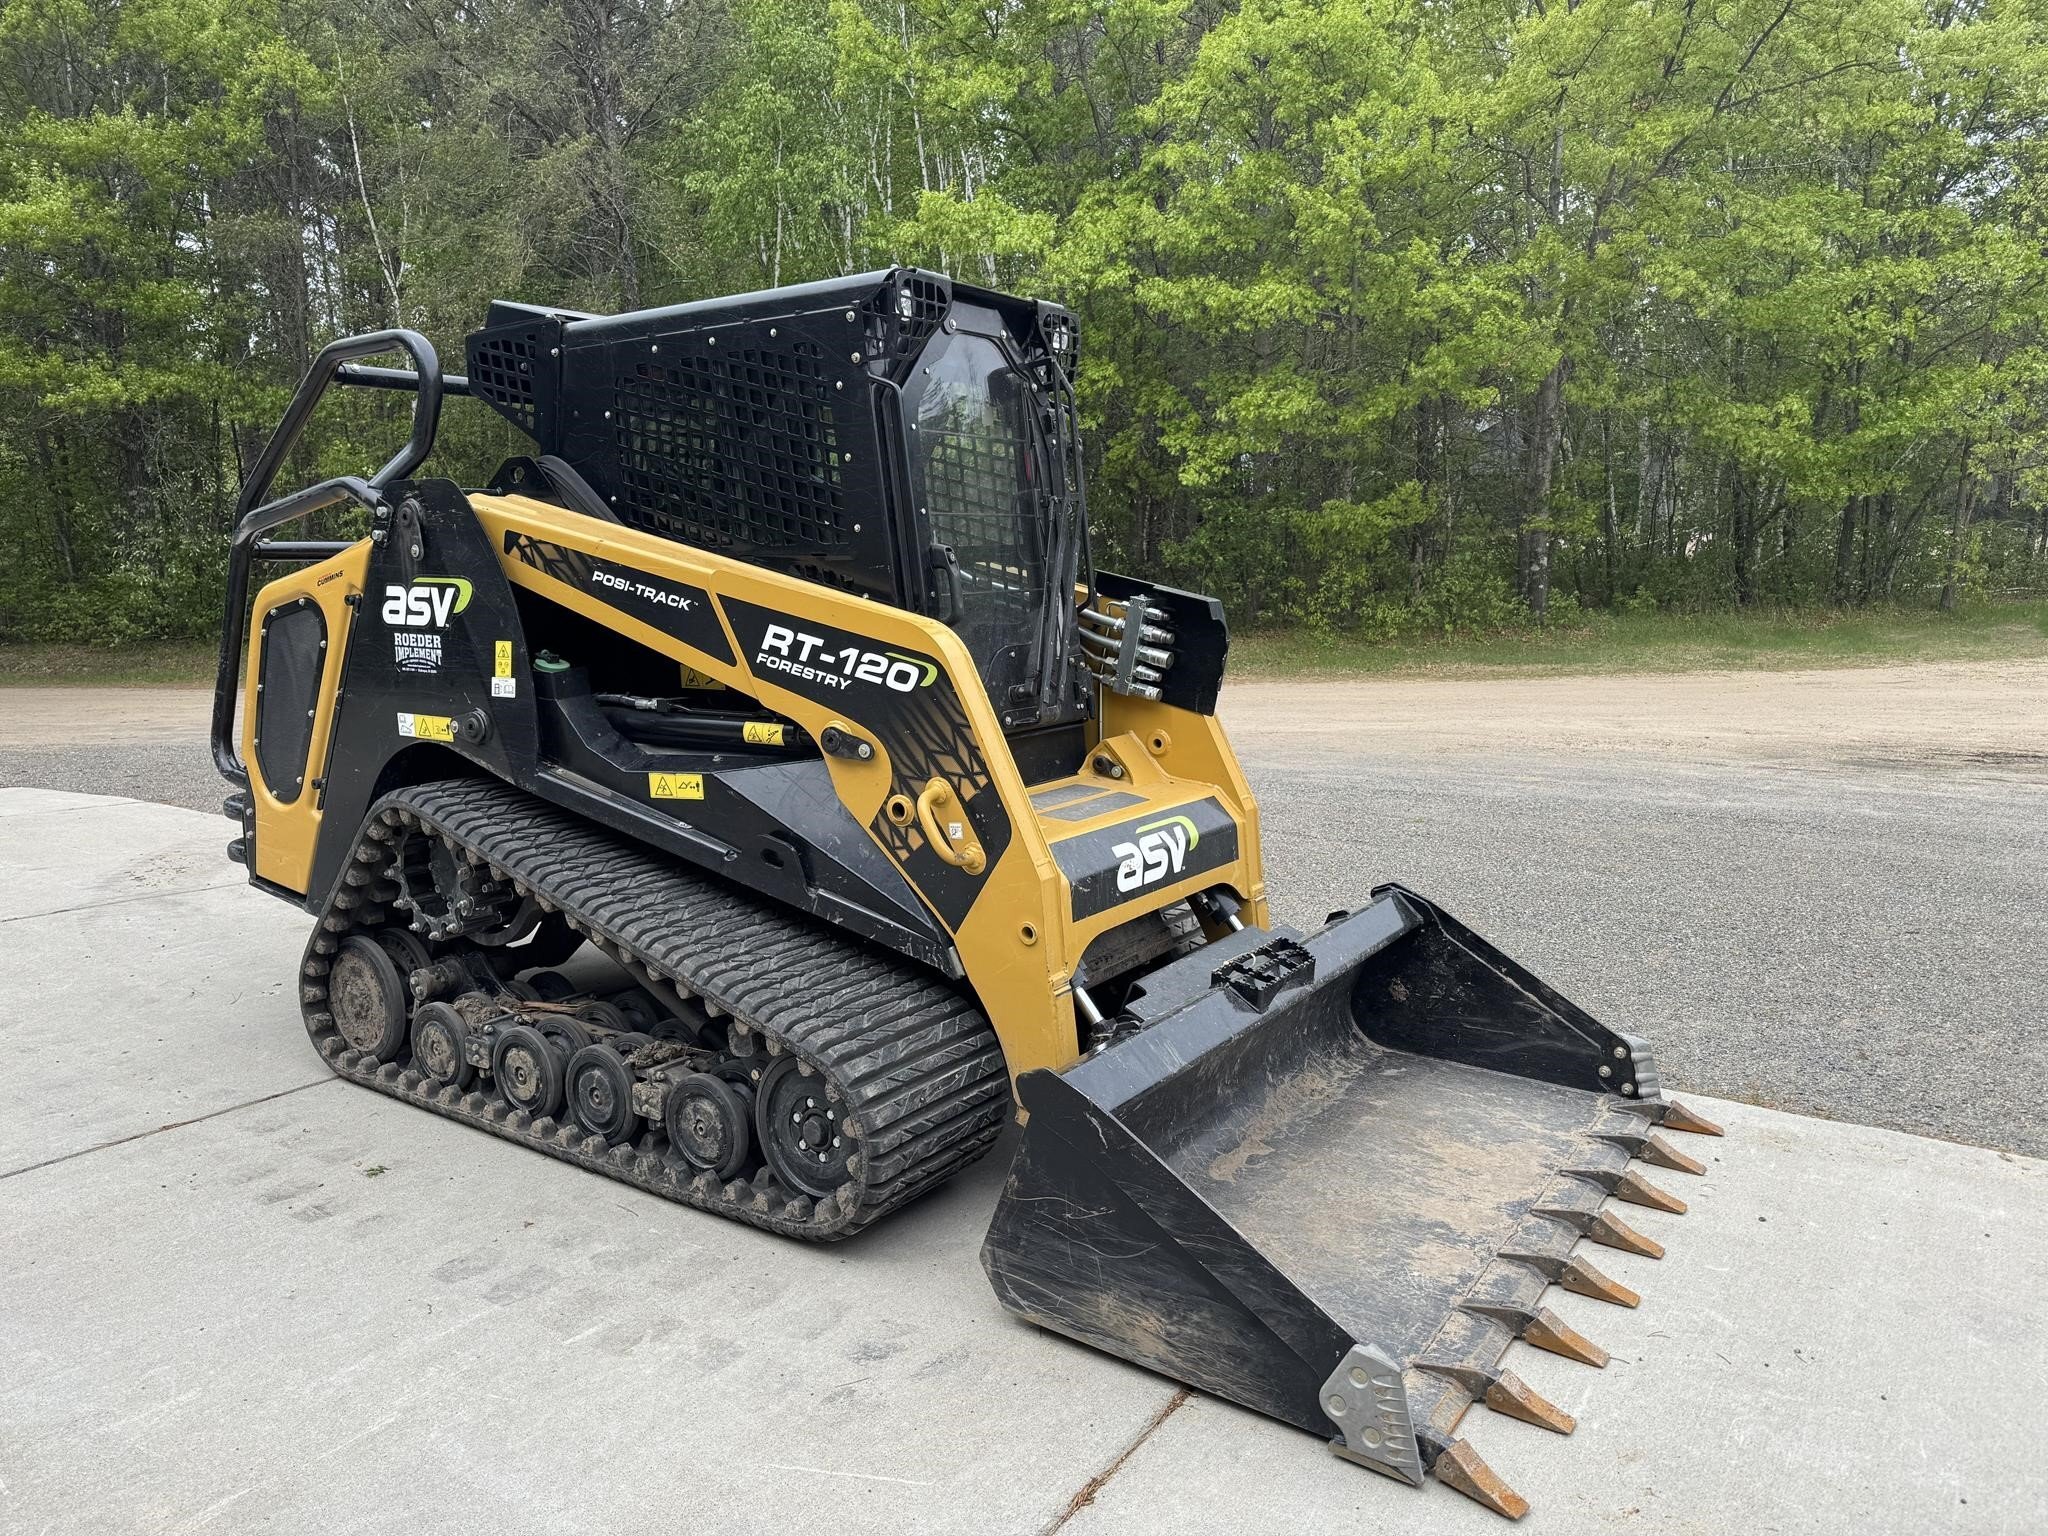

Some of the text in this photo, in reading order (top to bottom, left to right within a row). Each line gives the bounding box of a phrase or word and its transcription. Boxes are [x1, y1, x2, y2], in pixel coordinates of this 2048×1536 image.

[592, 570, 692, 611] POSI-TRACK
[394, 632, 442, 649] ROEDER
[395, 646, 442, 666] IMPLEMENT
[761, 623, 920, 693] RT-120
[756, 652, 852, 690] FORESTRY
